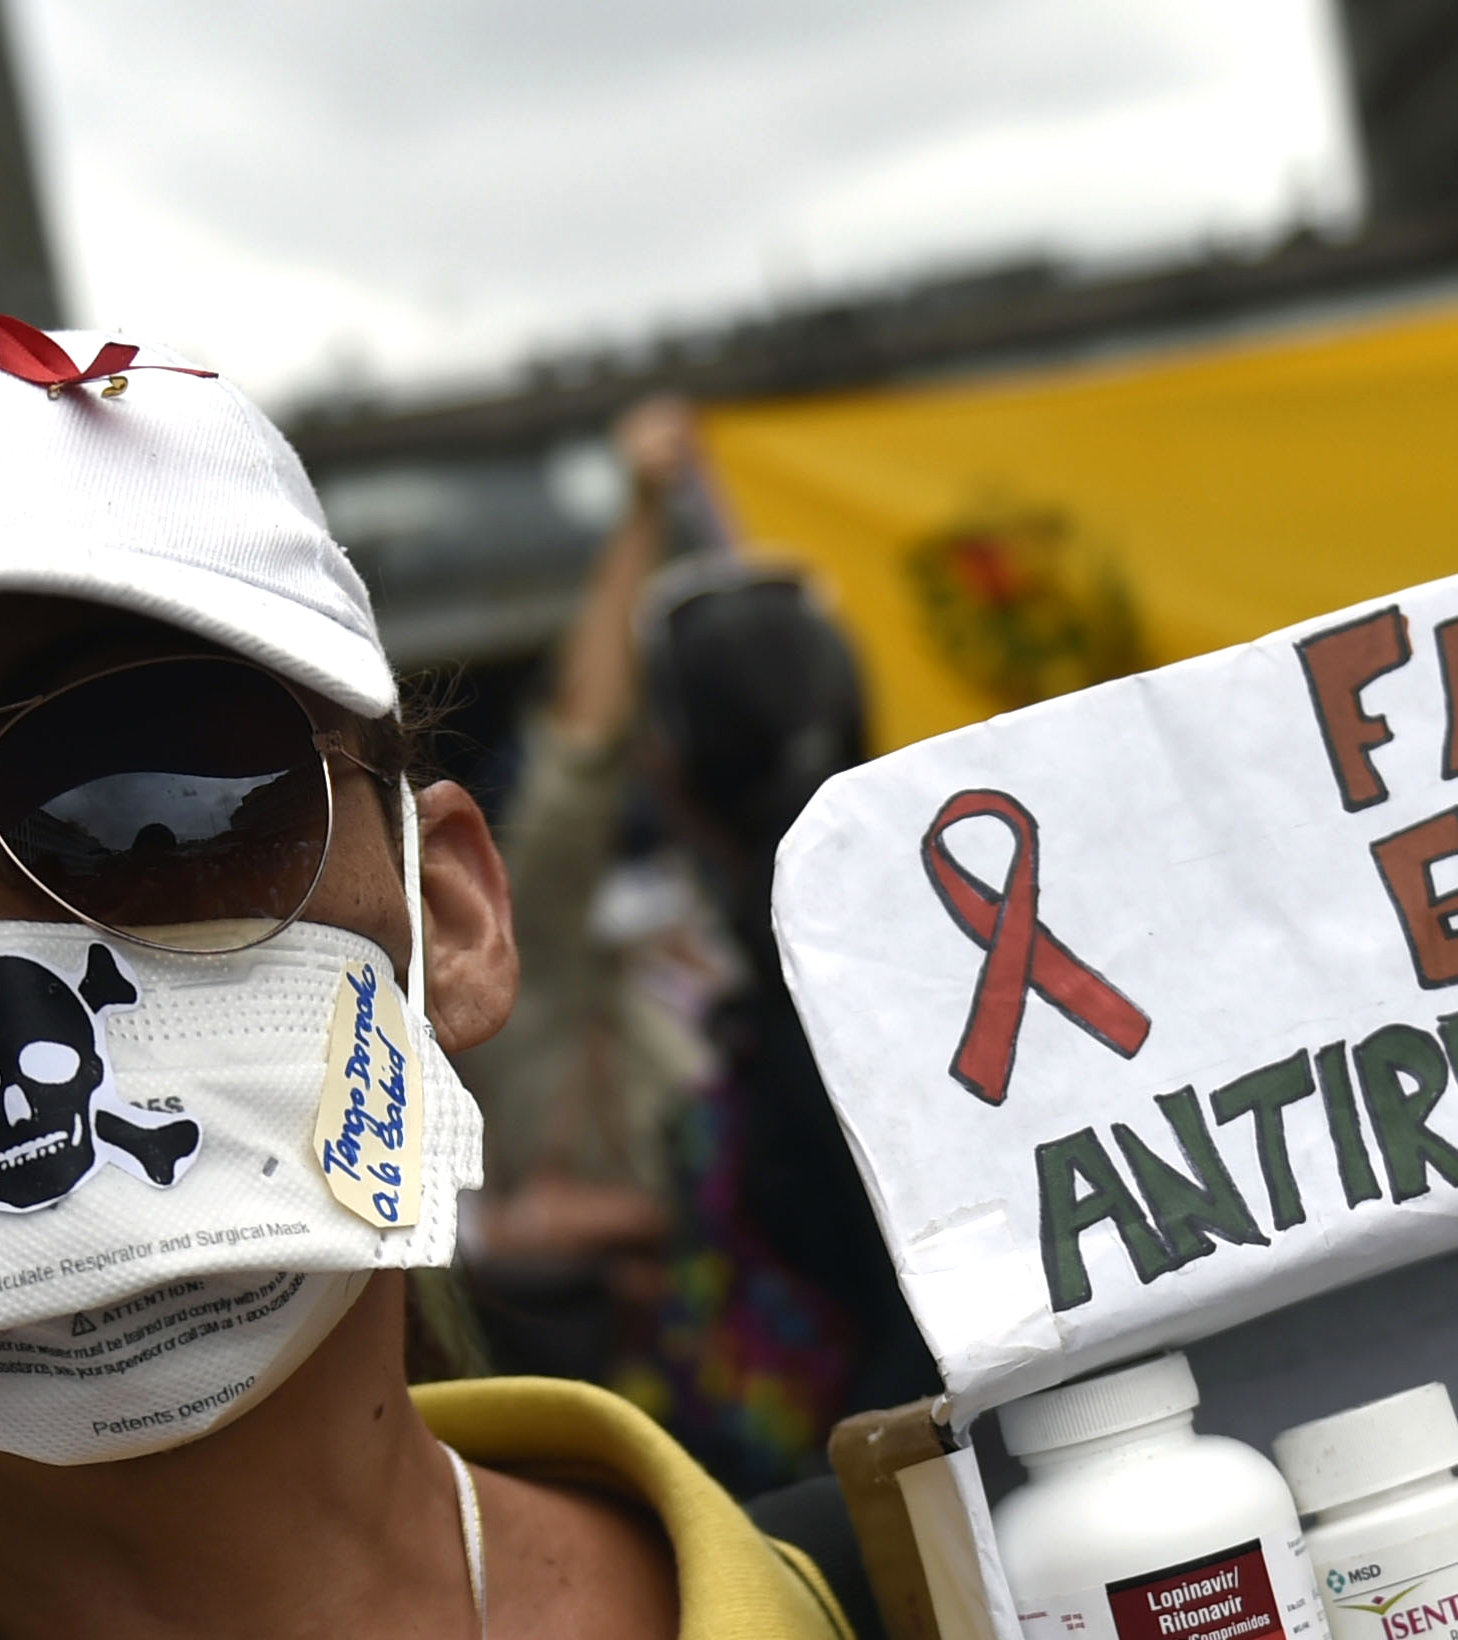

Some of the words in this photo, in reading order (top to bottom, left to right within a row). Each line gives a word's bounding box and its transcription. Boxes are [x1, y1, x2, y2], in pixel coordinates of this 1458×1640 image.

[324, 1087, 383, 1182] Tengo
[60, 1243, 152, 1276] Respirator
[159, 1234, 191, 1253] and
[195, 1224, 264, 1246] Surgical
[268, 1222, 310, 1237] Mask
[92, 1410, 173, 1436] Patents
[1147, 1566, 1238, 1611] Lopinavir/
[1348, 1564, 1381, 1583] MSD
[1159, 1595, 1242, 1634] Ritonavir
